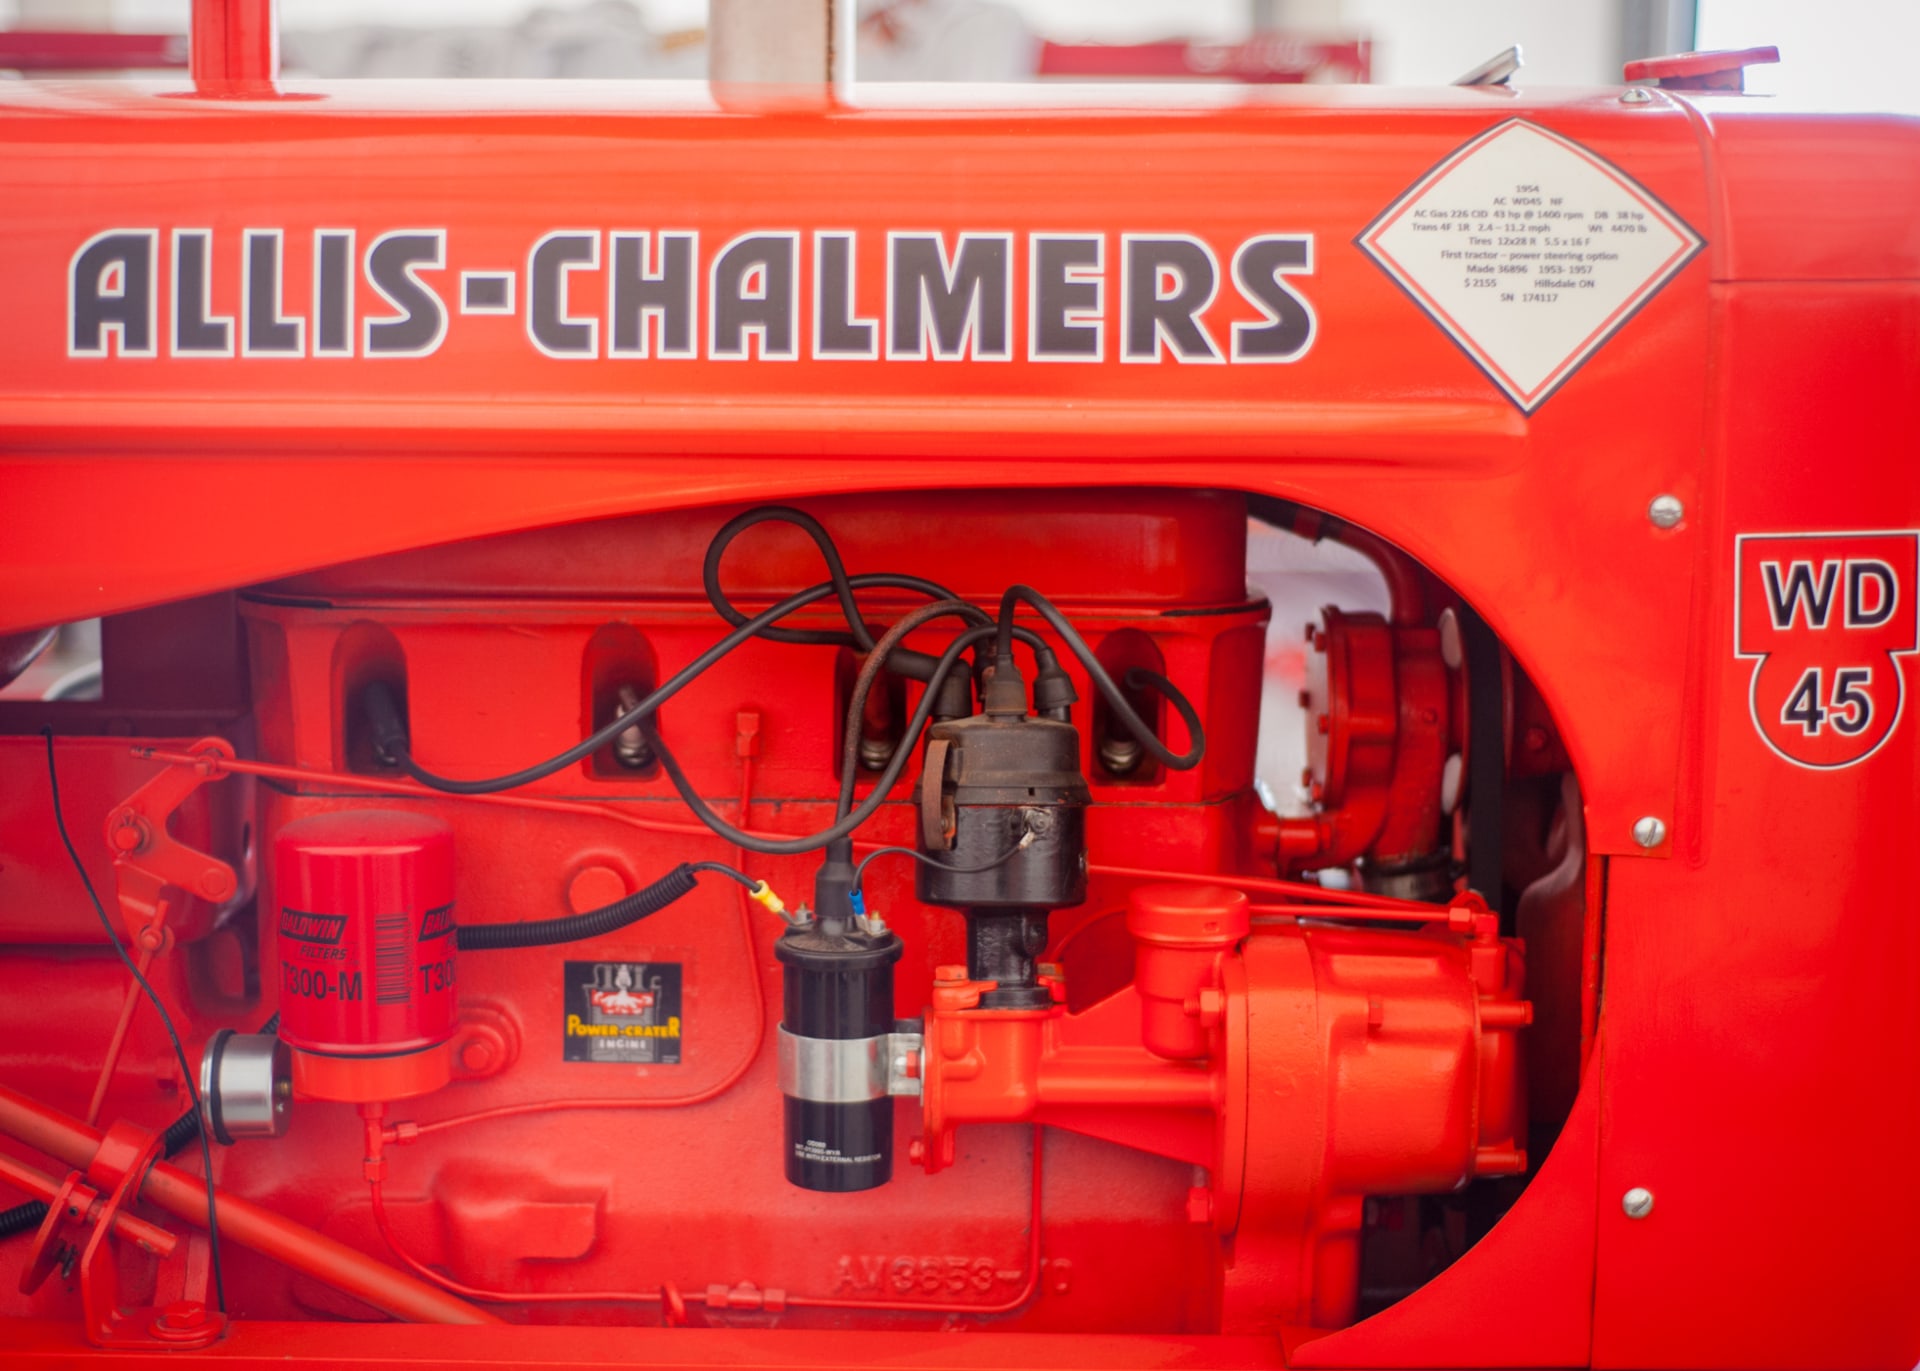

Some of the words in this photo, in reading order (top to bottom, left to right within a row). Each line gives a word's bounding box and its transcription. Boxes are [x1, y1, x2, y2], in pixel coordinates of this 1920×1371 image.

[1516, 185, 1540, 193] 1954
[1493, 197, 1507, 206] AC
[1512, 197, 1542, 206] WD45
[1550, 198, 1563, 206] NF
[1414, 210, 1427, 218] AC
[1430, 210, 1448, 218] Gas
[1451, 210, 1469, 218] 226
[1471, 210, 1488, 218] CID
[1493, 210, 1505, 218] 43
[1508, 210, 1521, 220] hp
[1524, 210, 1534, 220] @
[1538, 210, 1561, 219] 1400
[1564, 212, 1584, 221] rpm
[1594, 211, 1608, 219] DB
[1617, 211, 1629, 219] 38
[1631, 211, 1644, 221] hp
[1412, 223, 1437, 231] Trans
[1440, 223, 1452, 231] 4F
[1458, 223, 1470, 231] 1R
[1478, 223, 1493, 232] 2.4
[1504, 223, 1526, 232] 11.2
[1528, 224, 1551, 234] mph
[1588, 224, 1603, 233] Wt
[1611, 224, 1635, 233] 4470
[1637, 224, 1648, 233] lb
[1469, 237, 1492, 246] Tires
[1498, 237, 1527, 246] 12x28
[1530, 237, 1537, 246] R
[1544, 237, 1560, 246] 5.5
[1571, 237, 1582, 246] 16
[1585, 238, 1591, 246] F
[1441, 250, 1462, 259] First
[1465, 251, 1498, 260] tractor
[1509, 252, 1541, 261] power
[1544, 251, 1584, 262] steering
[1586, 252, 1619, 262] option
[1466, 264, 1495, 273] Made
[1498, 265, 1528, 274] 36896
[1569, 265, 1593, 274] 1957
[1473, 279, 1497, 288] 2155
[1534, 279, 1576, 288] Hillsdale
[1579, 279, 1595, 288] ON
[67, 227, 1318, 365] ALLIS-CHALMERS
[1500, 293, 1514, 302] SN
[1522, 293, 1558, 302] 174117
[1759, 558, 1900, 630] WD
[1780, 666, 1874, 737] 45
[281, 911, 342, 940] BALDWIN
[300, 943, 348, 961] FILTERS
[282, 960, 363, 1002] T300-M
